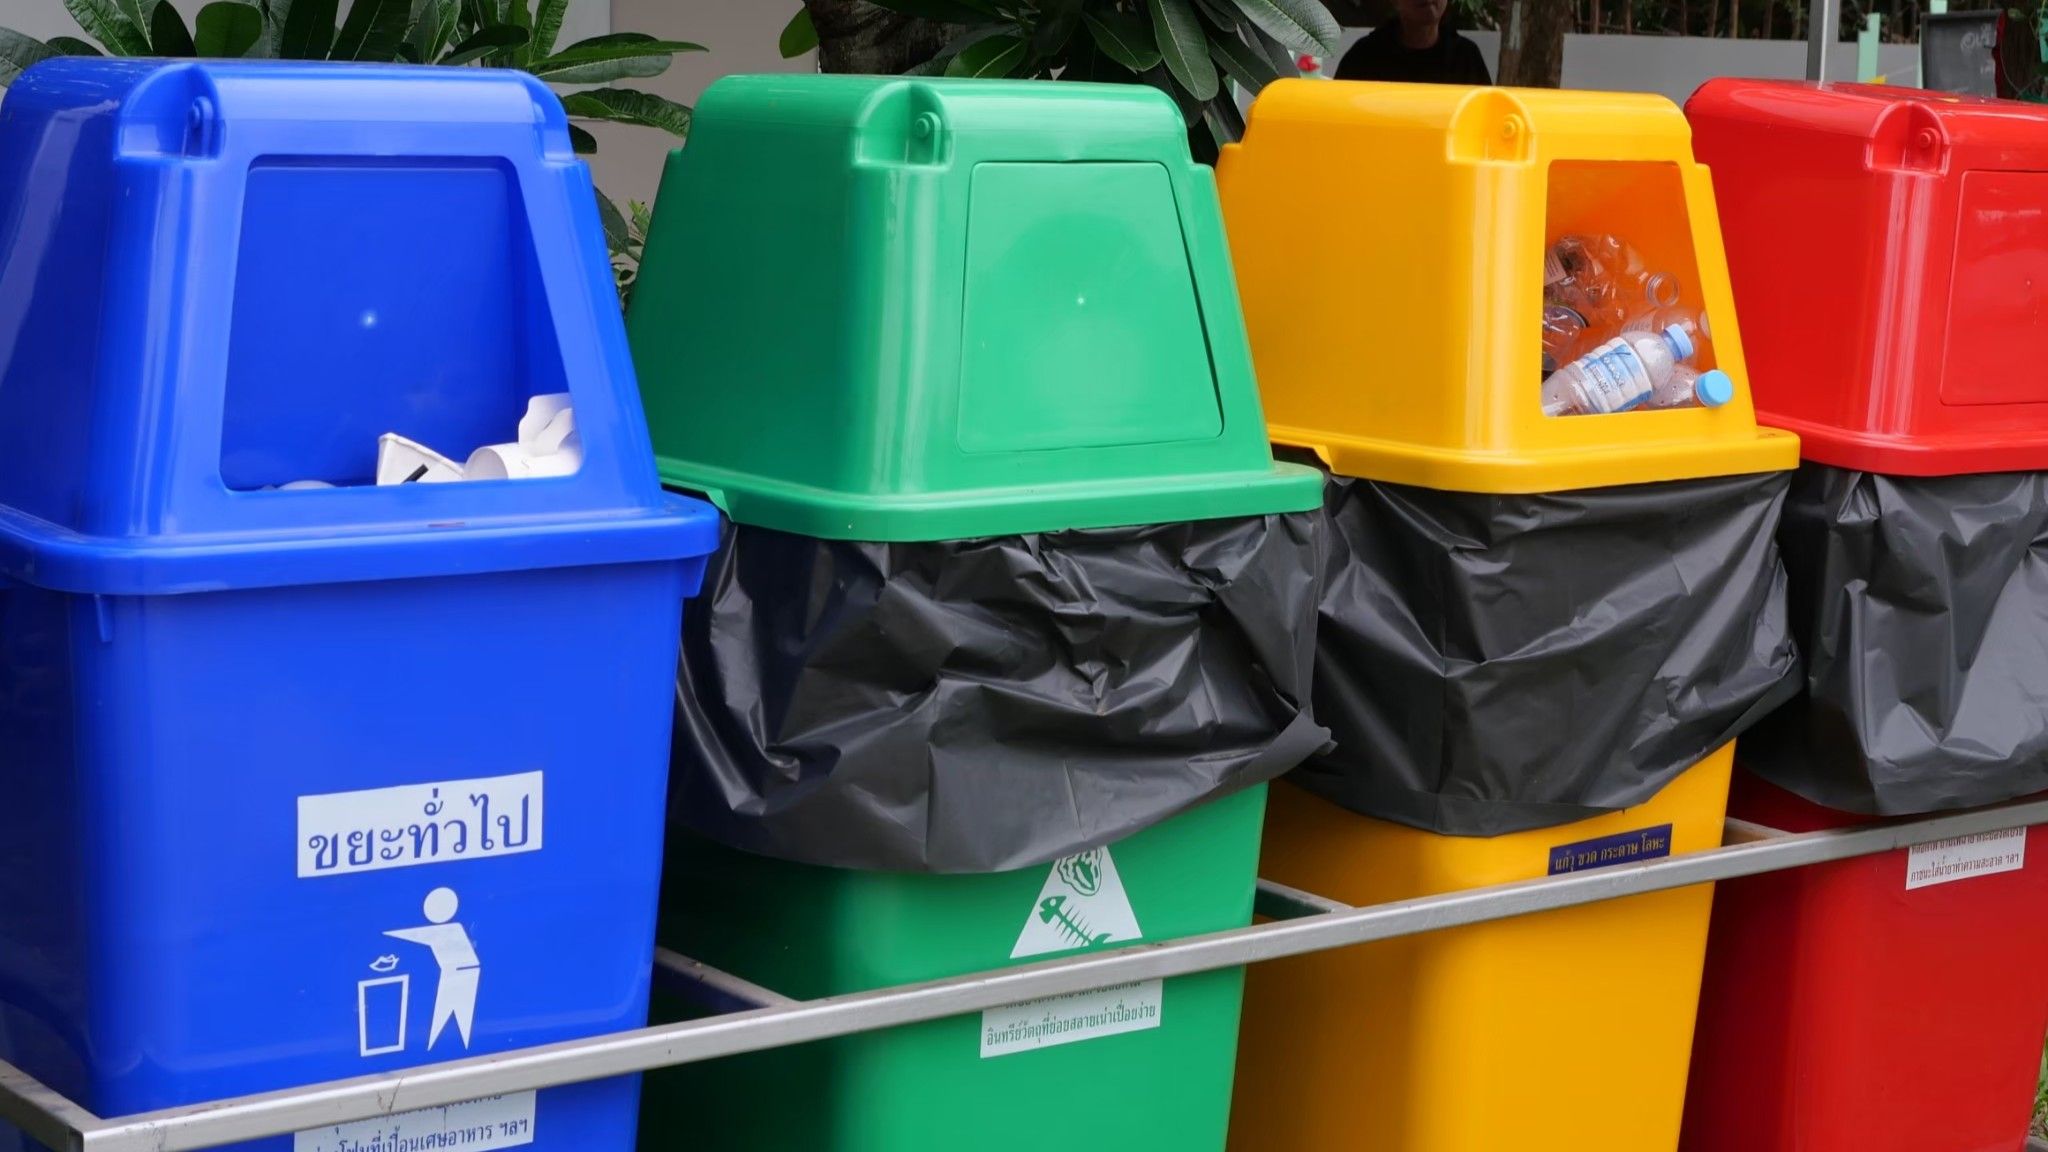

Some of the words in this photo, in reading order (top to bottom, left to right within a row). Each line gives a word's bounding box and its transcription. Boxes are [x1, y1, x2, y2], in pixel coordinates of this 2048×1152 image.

[308, 788, 529, 870] ขยะทั่วไป
[1578, 850, 1598, 866] ขวด
[1600, 842, 1639, 861] กระดาษ
[1641, 832, 1665, 853] โลหะ
[499, 1118, 529, 1138] ฯลฯ
